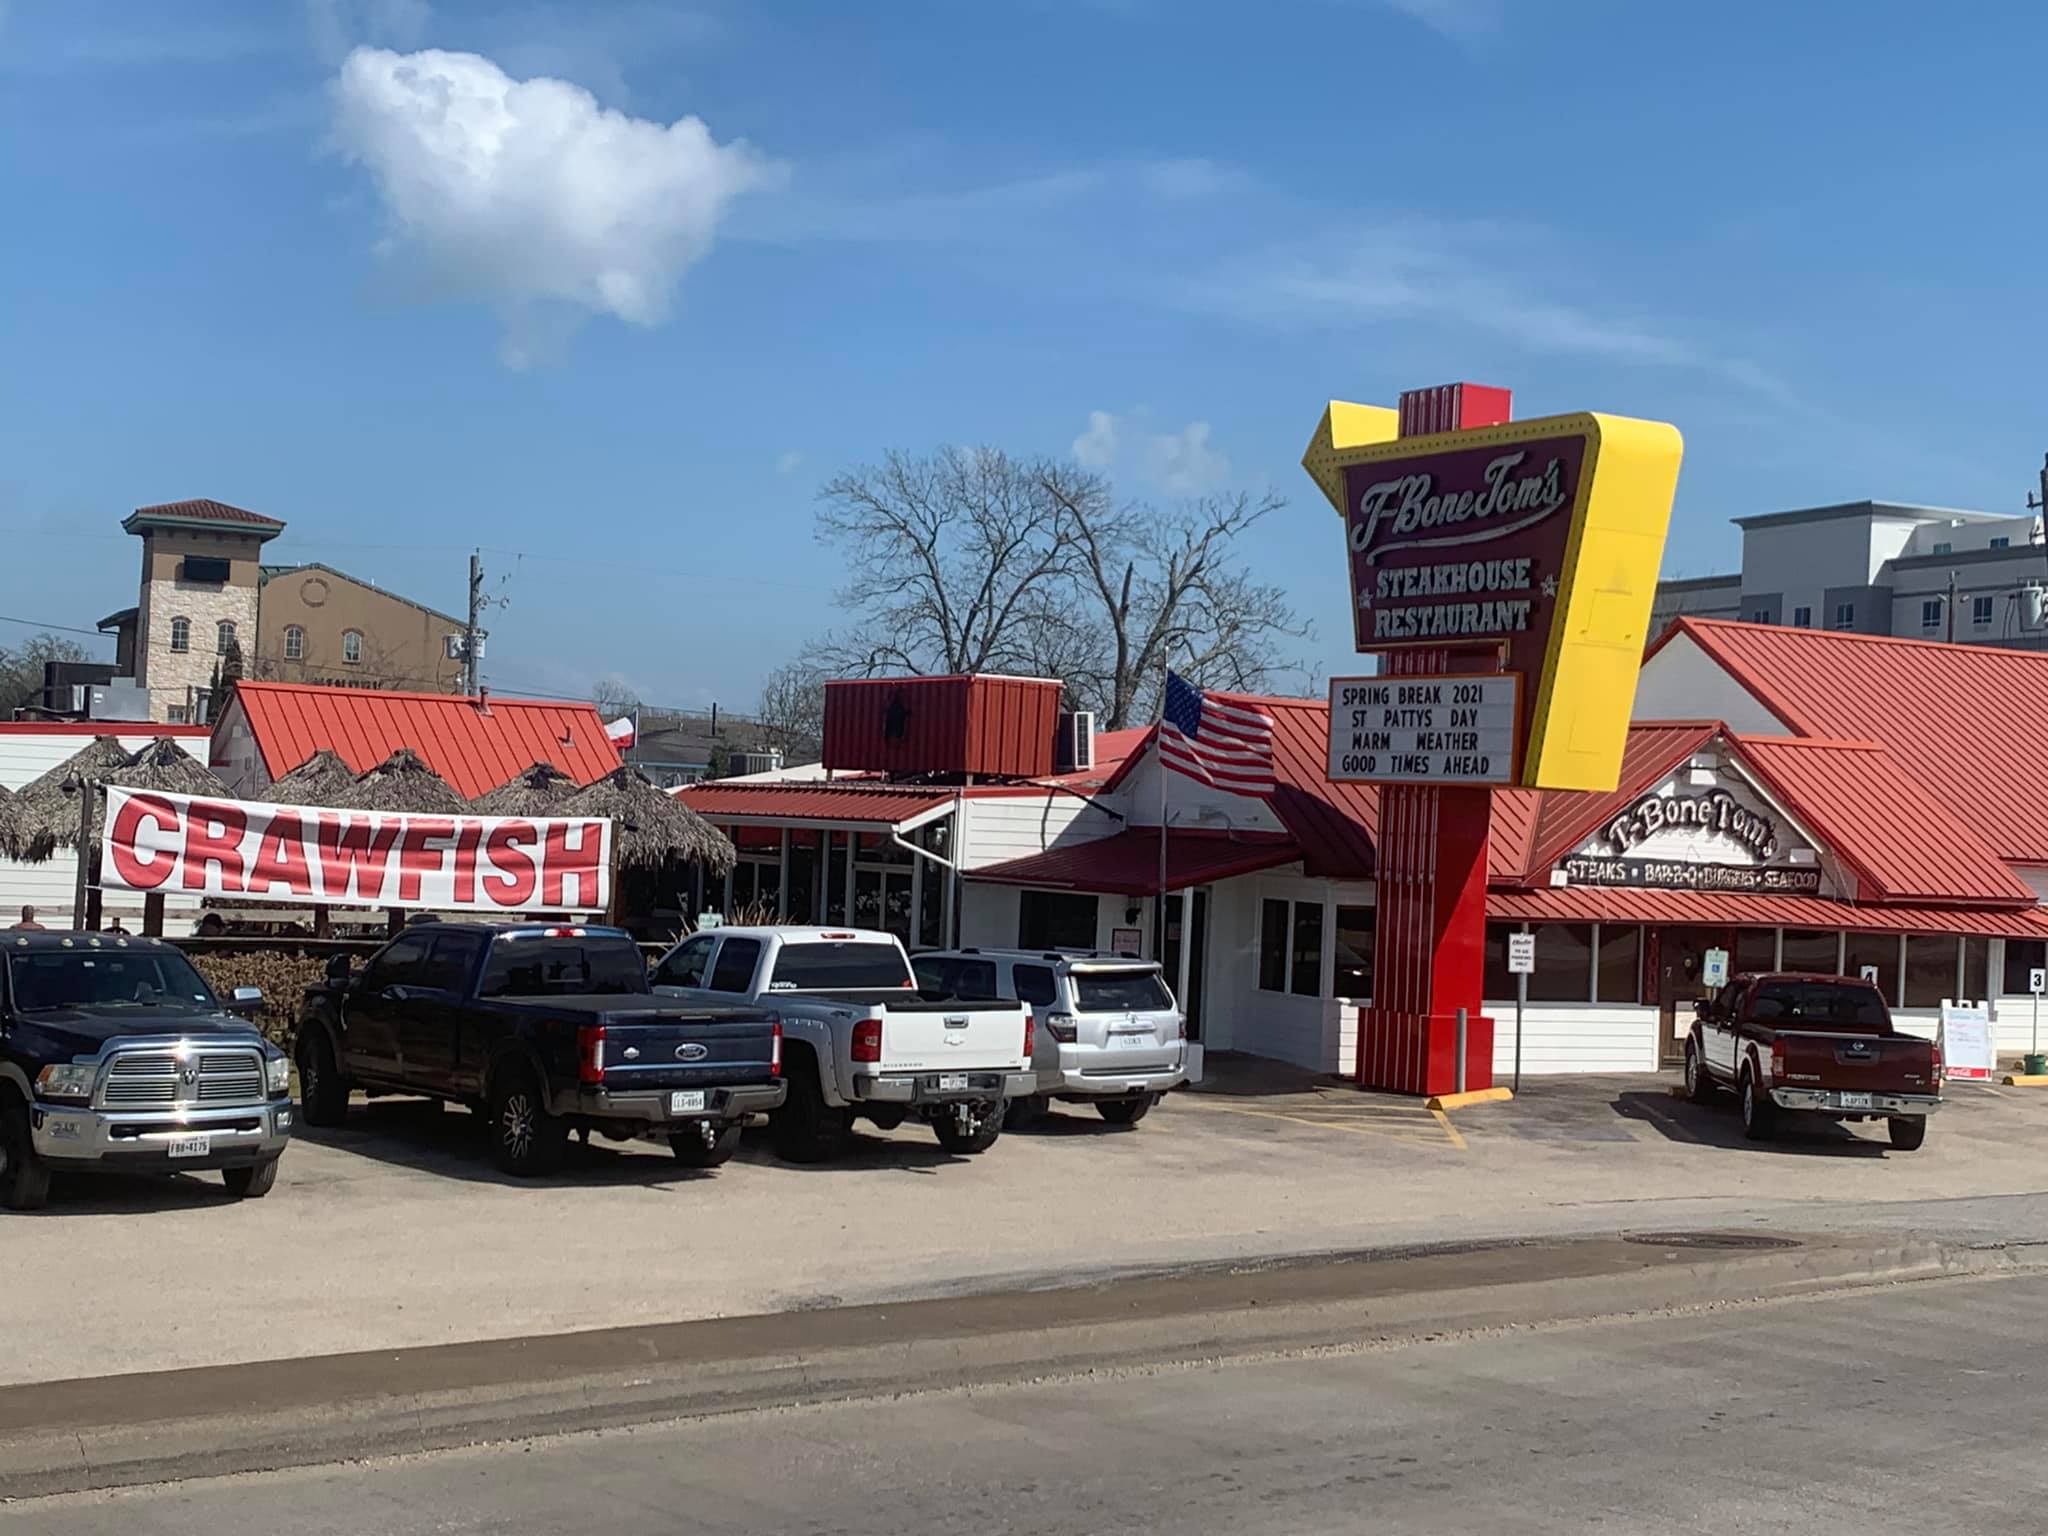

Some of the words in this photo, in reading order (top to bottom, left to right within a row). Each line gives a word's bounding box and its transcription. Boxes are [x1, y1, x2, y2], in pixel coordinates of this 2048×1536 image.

[1473, 450, 1566, 517] Tom's
[1376, 558, 1531, 599] STEAKHOUSE
[1374, 600, 1531, 638] RESTAURANT
[1342, 687, 1389, 706] SPRING
[1398, 686, 1441, 705] BREAK
[1453, 685, 1483, 704] 2021
[1352, 710, 1367, 728] ST
[1383, 709, 1432, 728] PATTYS
[1450, 709, 1478, 727] DAY
[1352, 732, 1391, 750] WARM
[1416, 732, 1478, 750] WEATHER
[1342, 755, 1376, 773] GOOD
[1391, 755, 1430, 774] TIMES
[1443, 756, 1489, 775] AHEAD
[1608, 797, 1712, 850] T-Bone
[1713, 793, 1779, 858] Tom's
[111, 793, 606, 908] CRAWFISH
[1566, 859, 1626, 881] STEAKS
[1764, 870, 1819, 889] SEAFOOD
[2033, 973, 2042, 988] 3
